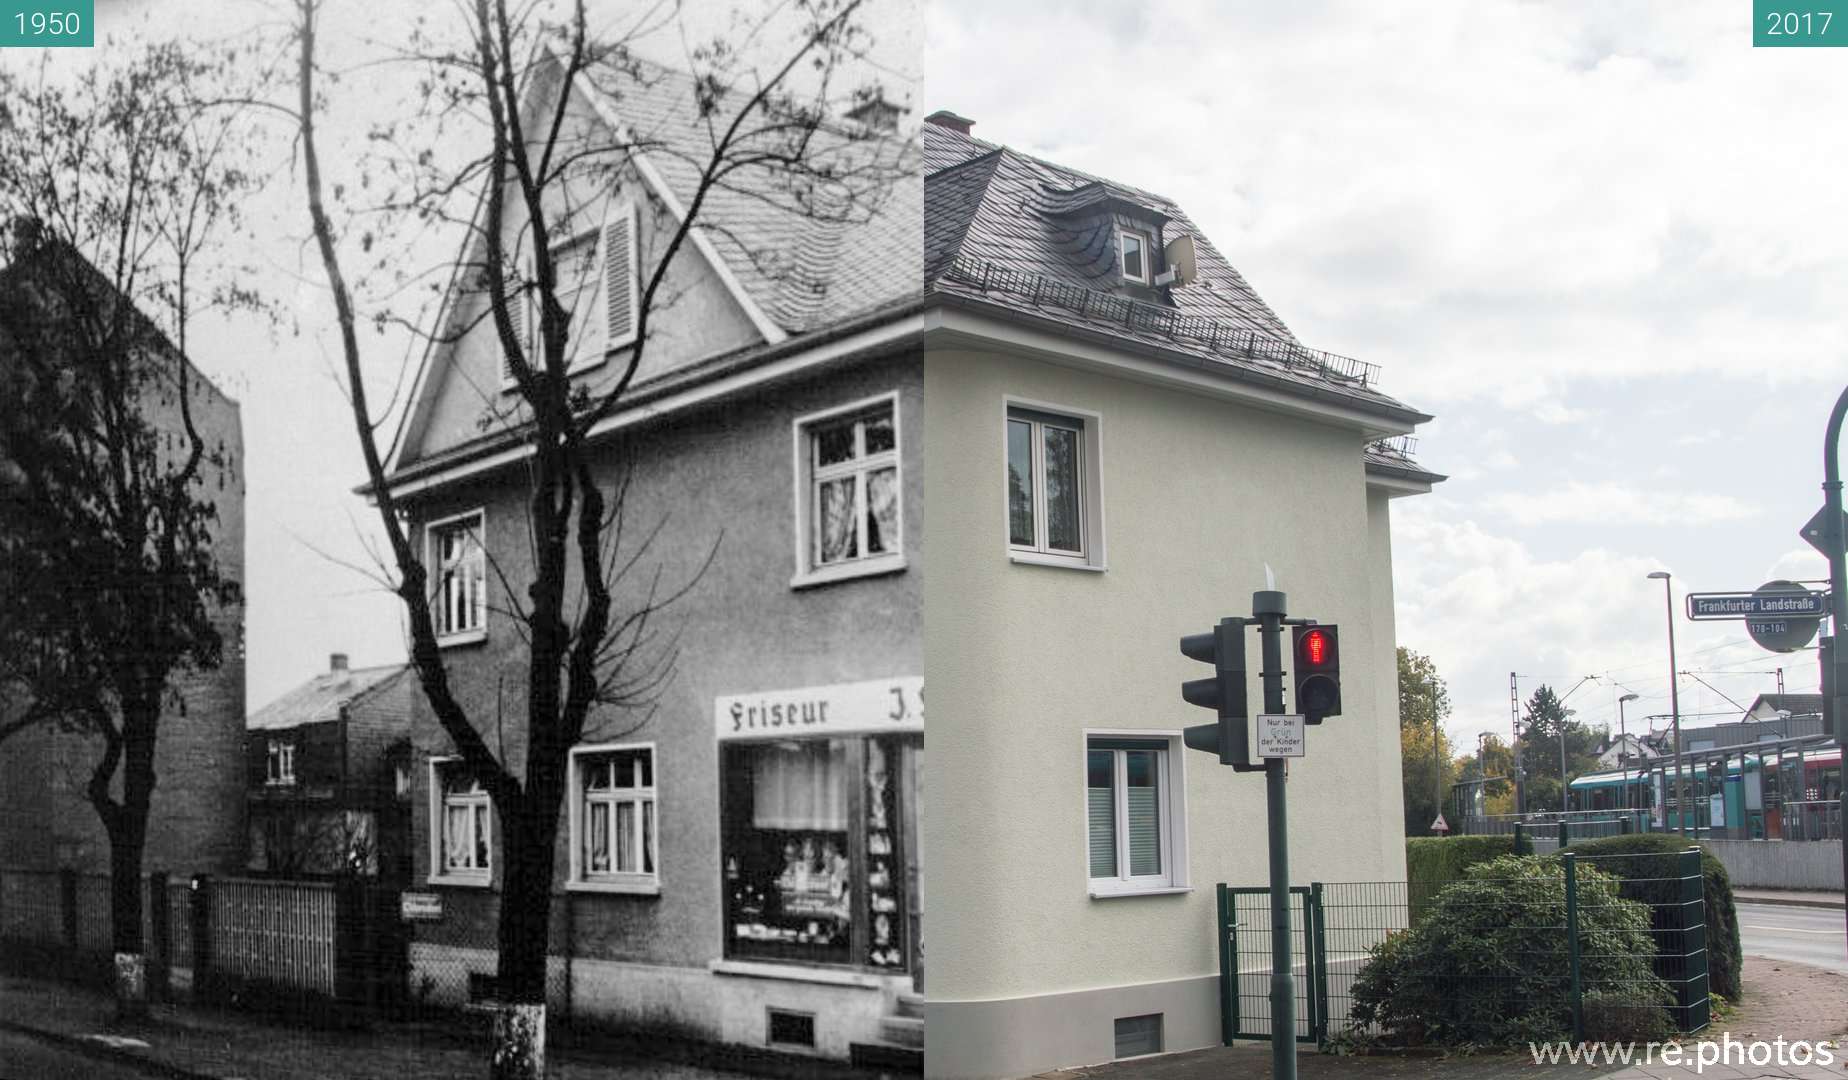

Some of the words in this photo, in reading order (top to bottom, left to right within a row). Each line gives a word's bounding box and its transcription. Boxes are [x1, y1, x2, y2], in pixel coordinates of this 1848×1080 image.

[1698, 599, 1755, 612] Frankfurter
[1760, 598, 1815, 611] Landstraße
[729, 700, 829, 732] Friseur
[1270, 727, 1291, 737] Grün
[1277, 738, 1300, 746] Kinder
